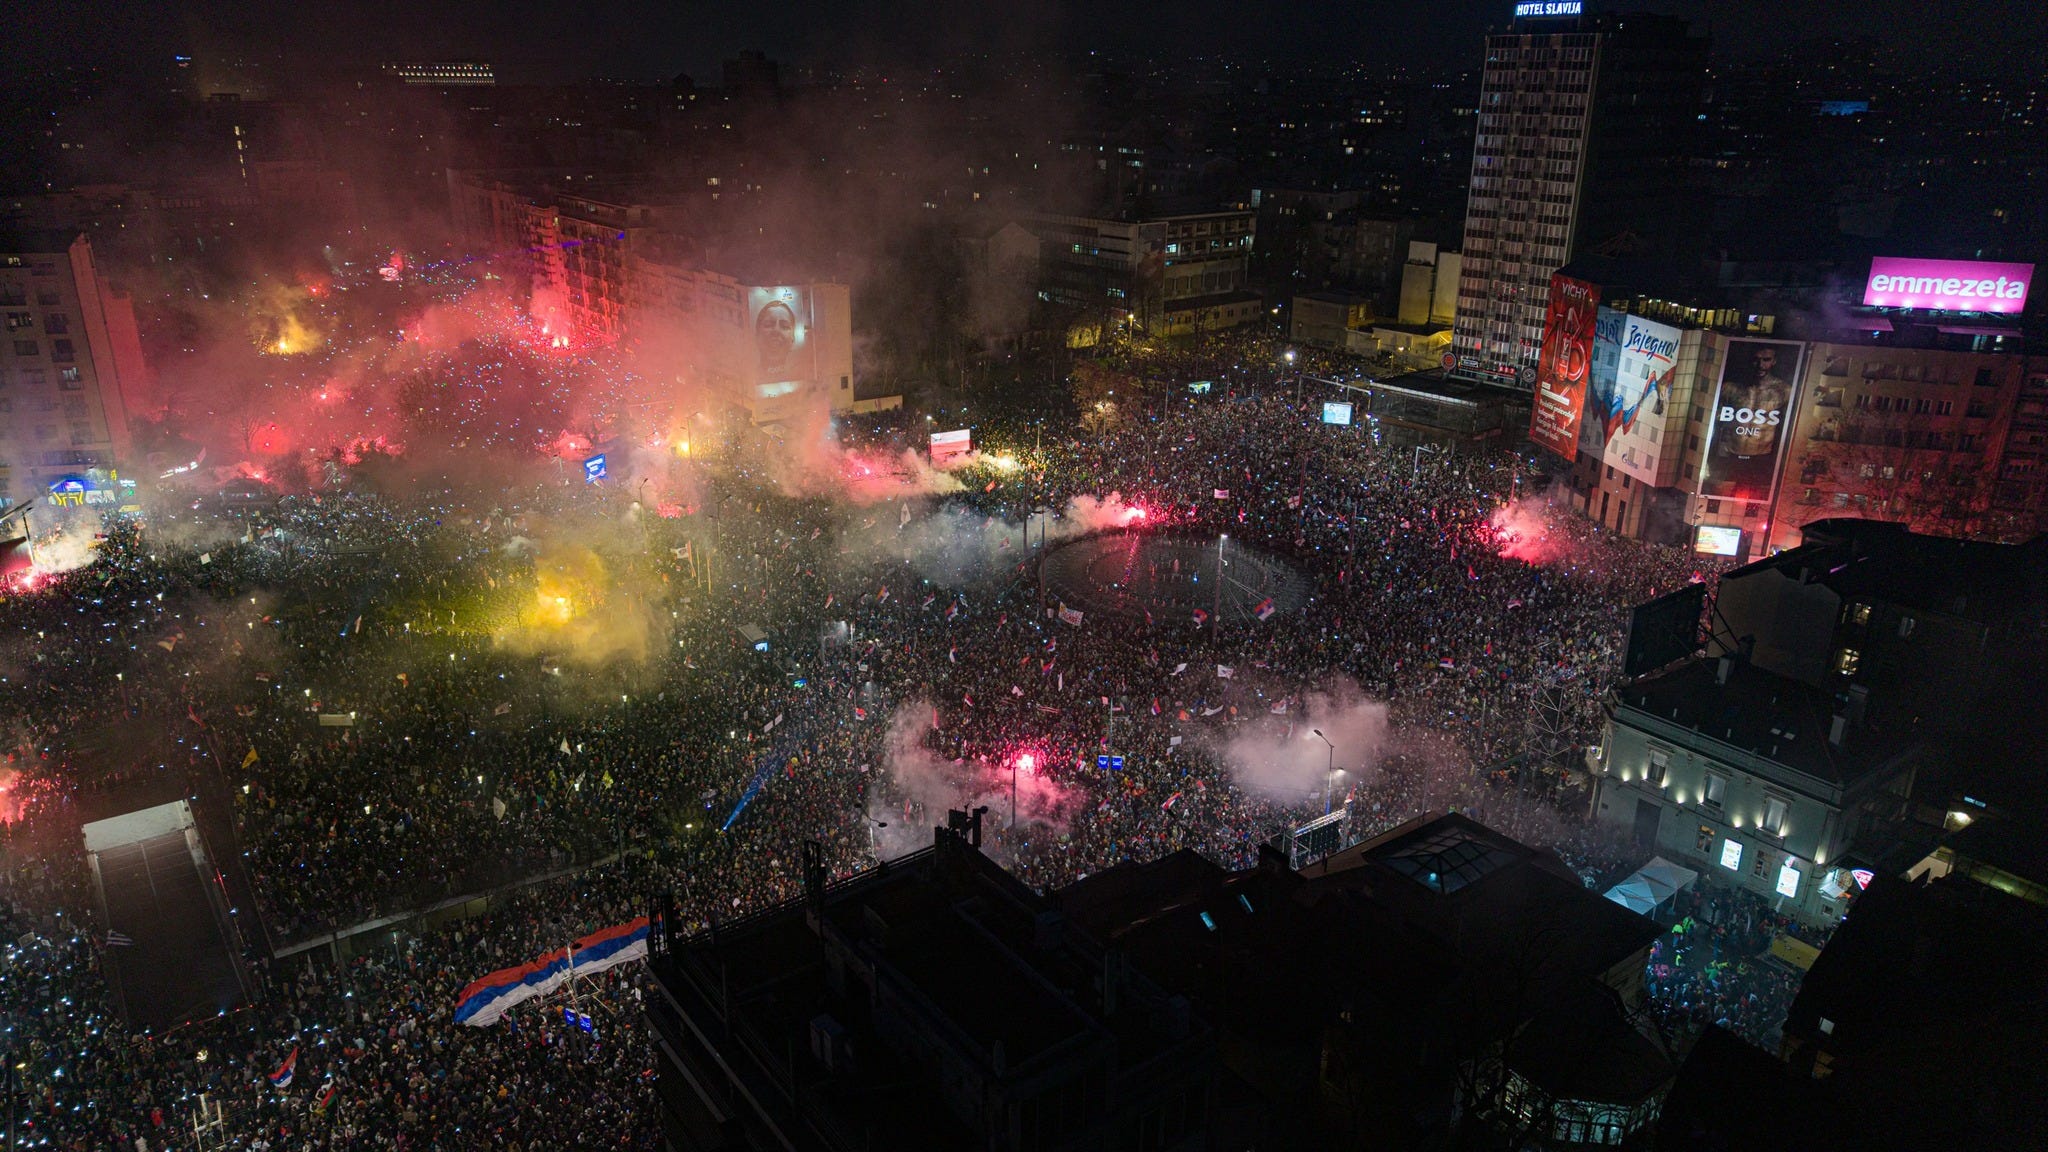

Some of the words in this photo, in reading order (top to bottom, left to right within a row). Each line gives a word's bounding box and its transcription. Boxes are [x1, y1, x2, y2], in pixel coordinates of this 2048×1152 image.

[1516, 3, 1544, 16] HOTEL
[1545, 2, 1581, 15] SLAVIJA
[1562, 282, 1588, 300] VICHY
[1871, 274, 2025, 299] emmezeta
[1720, 406, 1780, 426] BOSS
[1736, 426, 1760, 438] ONE
